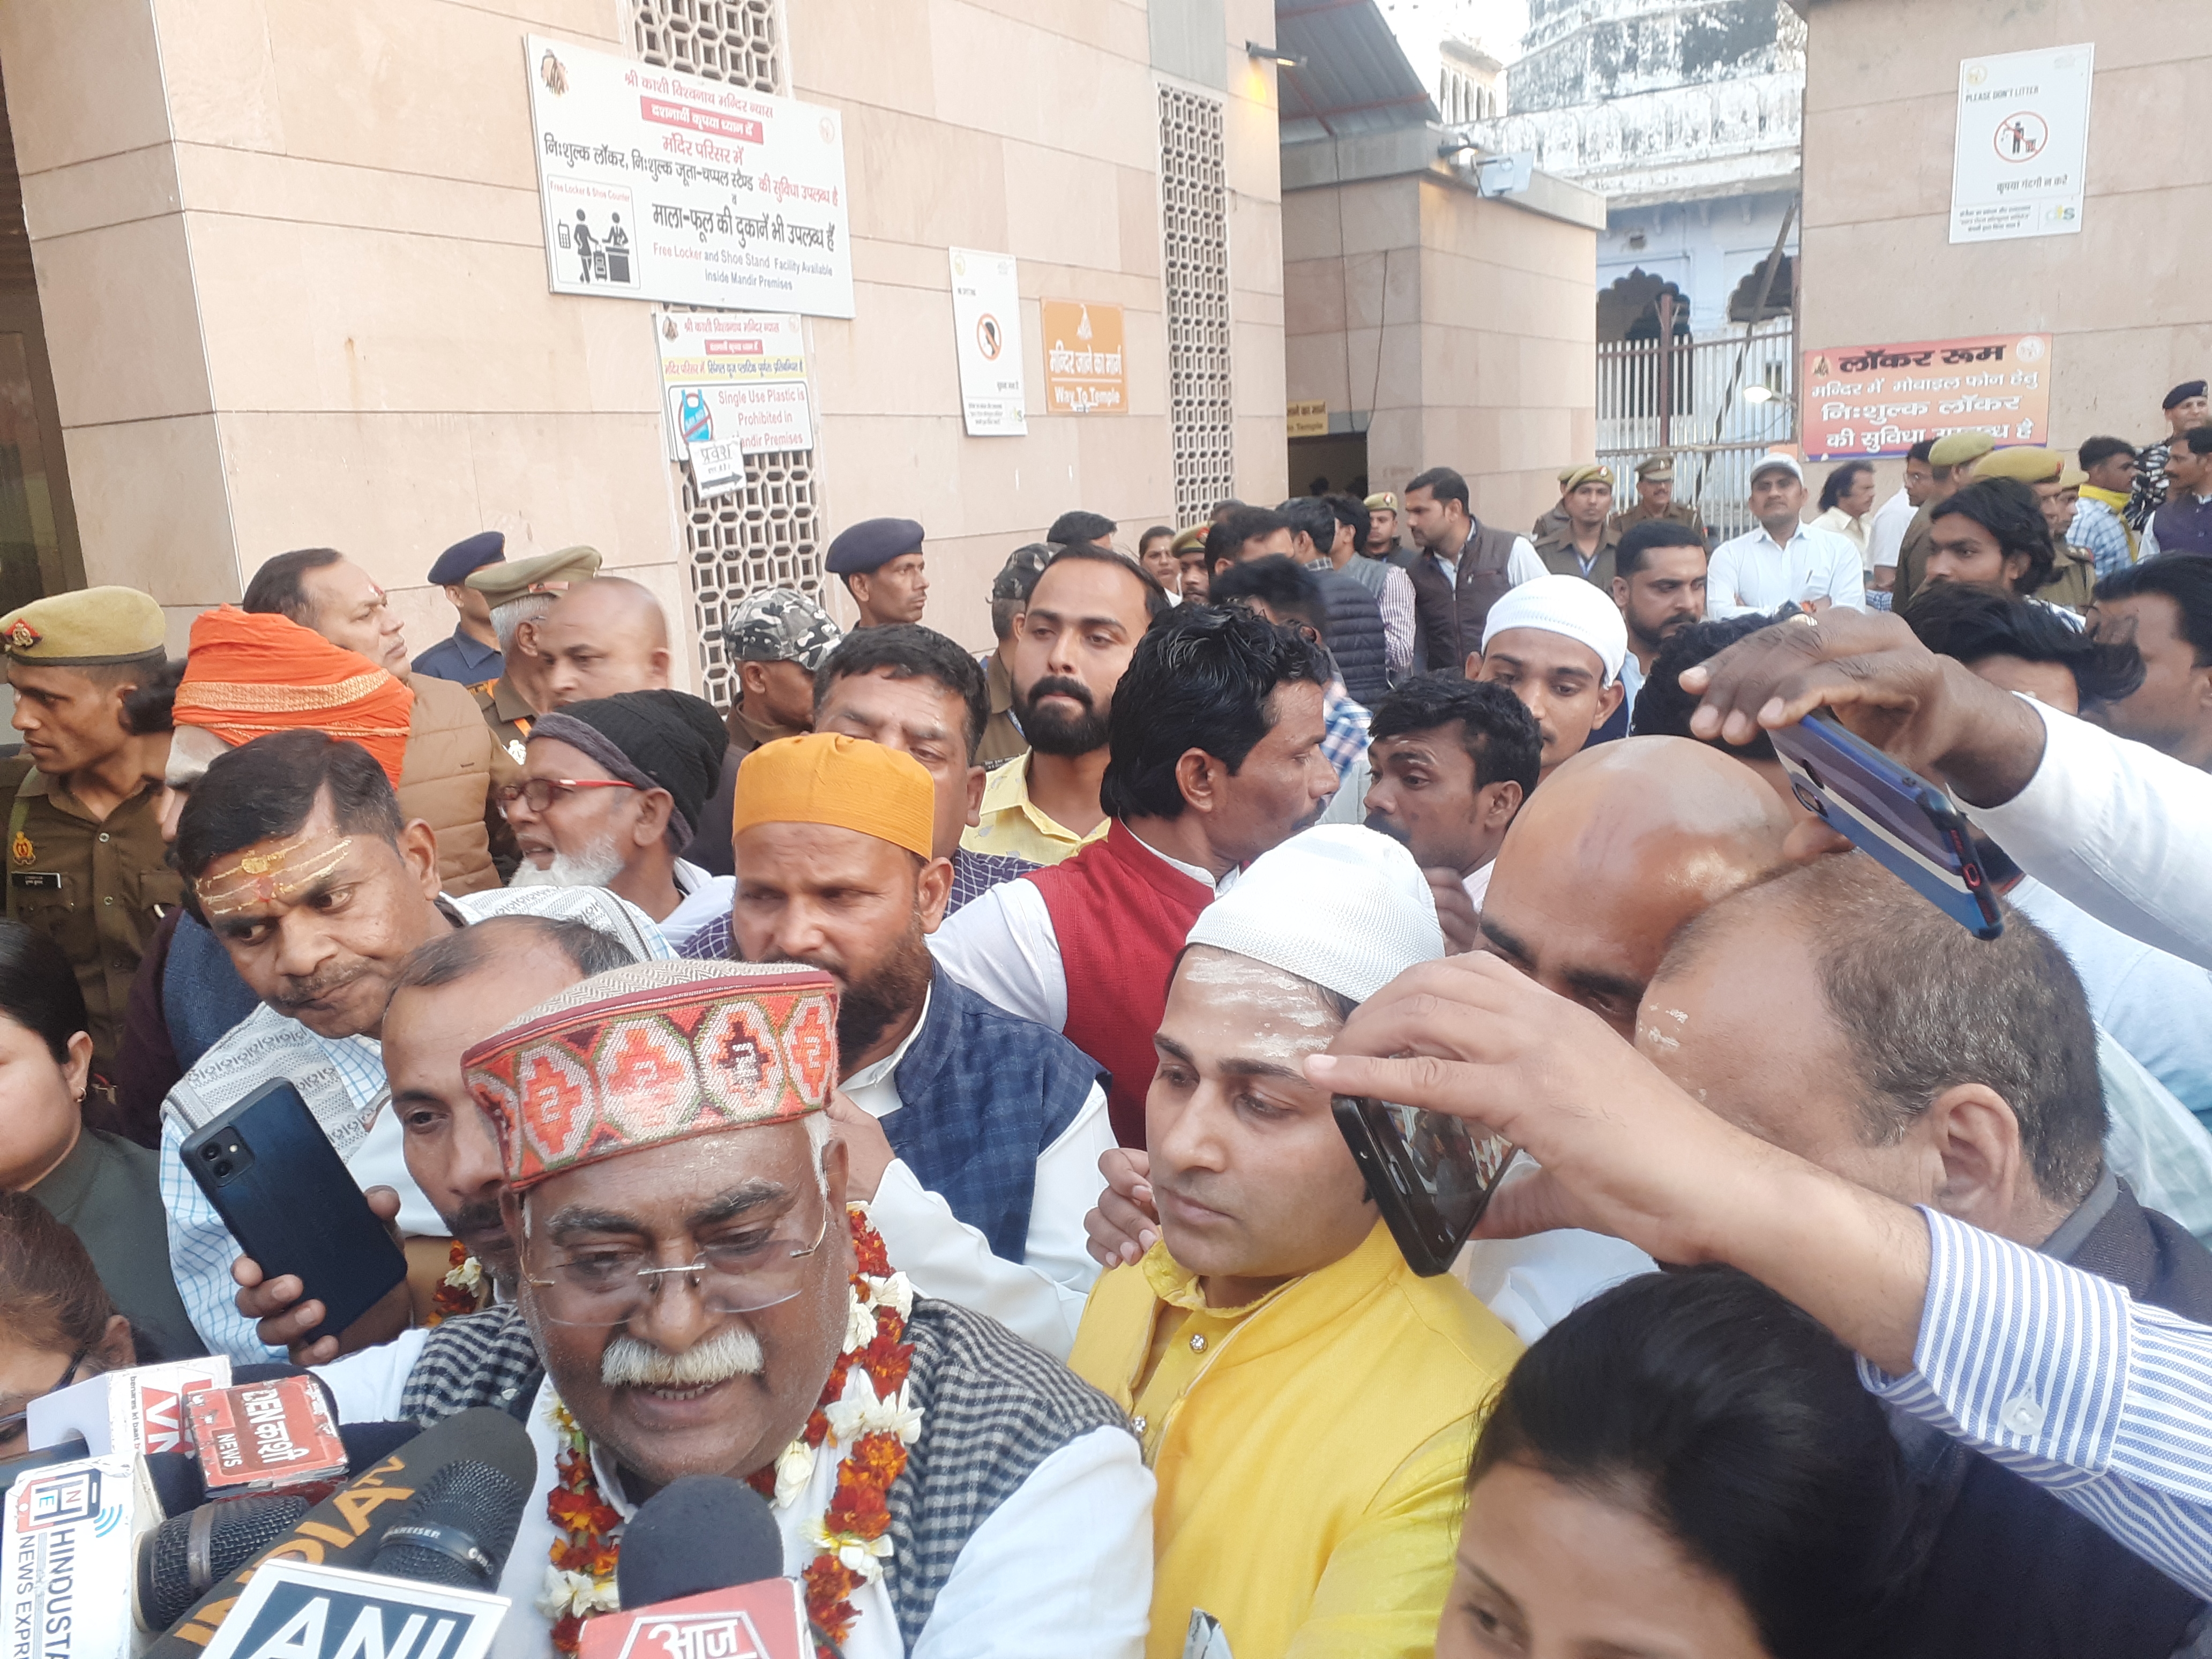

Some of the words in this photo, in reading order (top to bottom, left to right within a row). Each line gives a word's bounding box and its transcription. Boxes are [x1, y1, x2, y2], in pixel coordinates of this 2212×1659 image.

[625, 70, 639, 87] श्री
[642, 76, 669, 94] काशी
[1966, 92, 1990, 102] PLEASE
[696, 138, 731, 165] परिसर
[733, 145, 744, 166] में
[544, 132, 591, 168] निःशुल्क
[593, 143, 629, 170] लॉकर,
[631, 148, 673, 182] निःशुल्क
[675, 161, 729, 188] जूता-चप्पल
[758, 173, 771, 193] की
[773, 176, 799, 203] सुविधा
[802, 185, 829, 204] उपलब्ध
[550, 181, 564, 192] Free
[652, 203, 714, 244] माला-फूल
[716, 205, 733, 236] की
[735, 212, 769, 249] दुकानें
[772, 213, 785, 243] भी
[787, 223, 824, 249] उपलब्ध
[653, 242, 672, 257] Free
[674, 245, 703, 261] Locker
[704, 250, 719, 263] and
[721, 250, 743, 266] Shoe
[745, 252, 771, 268] Stand
[774, 257, 801, 275] Facility
[802, 261, 833, 277] Available
[705, 268, 729, 285] Inside
[731, 271, 757, 287] Mandir
[759, 274, 793, 291] Premises
[1838, 349, 1935, 373] लॉकर
[1940, 345, 2007, 364] रूम
[718, 390, 746, 407] Single
[748, 390, 764, 403] Use
[767, 388, 796, 402] Plastic
[797, 387, 805, 401] is
[1054, 386, 1075, 405] Way
[1075, 386, 1088, 403] To
[1089, 386, 1120, 407] Temple
[1812, 380, 1864, 398] मन्दिर
[1867, 377, 1886, 394] में
[1893, 376, 1961, 392] मोबाइल
[1965, 371, 2005, 388] फोन
[2010, 368, 2039, 390] हेतु
[738, 412, 781, 426] Prohibited
[784, 410, 793, 423] in
[1821, 401, 1931, 425] निःशुल्क
[1938, 393, 2023, 415] लॉकर
[741, 435, 762, 449] andir
[764, 432, 803, 446] Premises
[1826, 428, 1856, 449] की
[1861, 424, 1926, 454] सुविधा
[217, 1433, 243, 1468] NEWS
[350, 1456, 405, 1489] TV
[17, 1534, 35, 1595] NEWS
[13, 1600, 33, 1659] EXPR
[248, 1596, 460, 1659] ANI
[647, 1618, 739, 1659] आज
